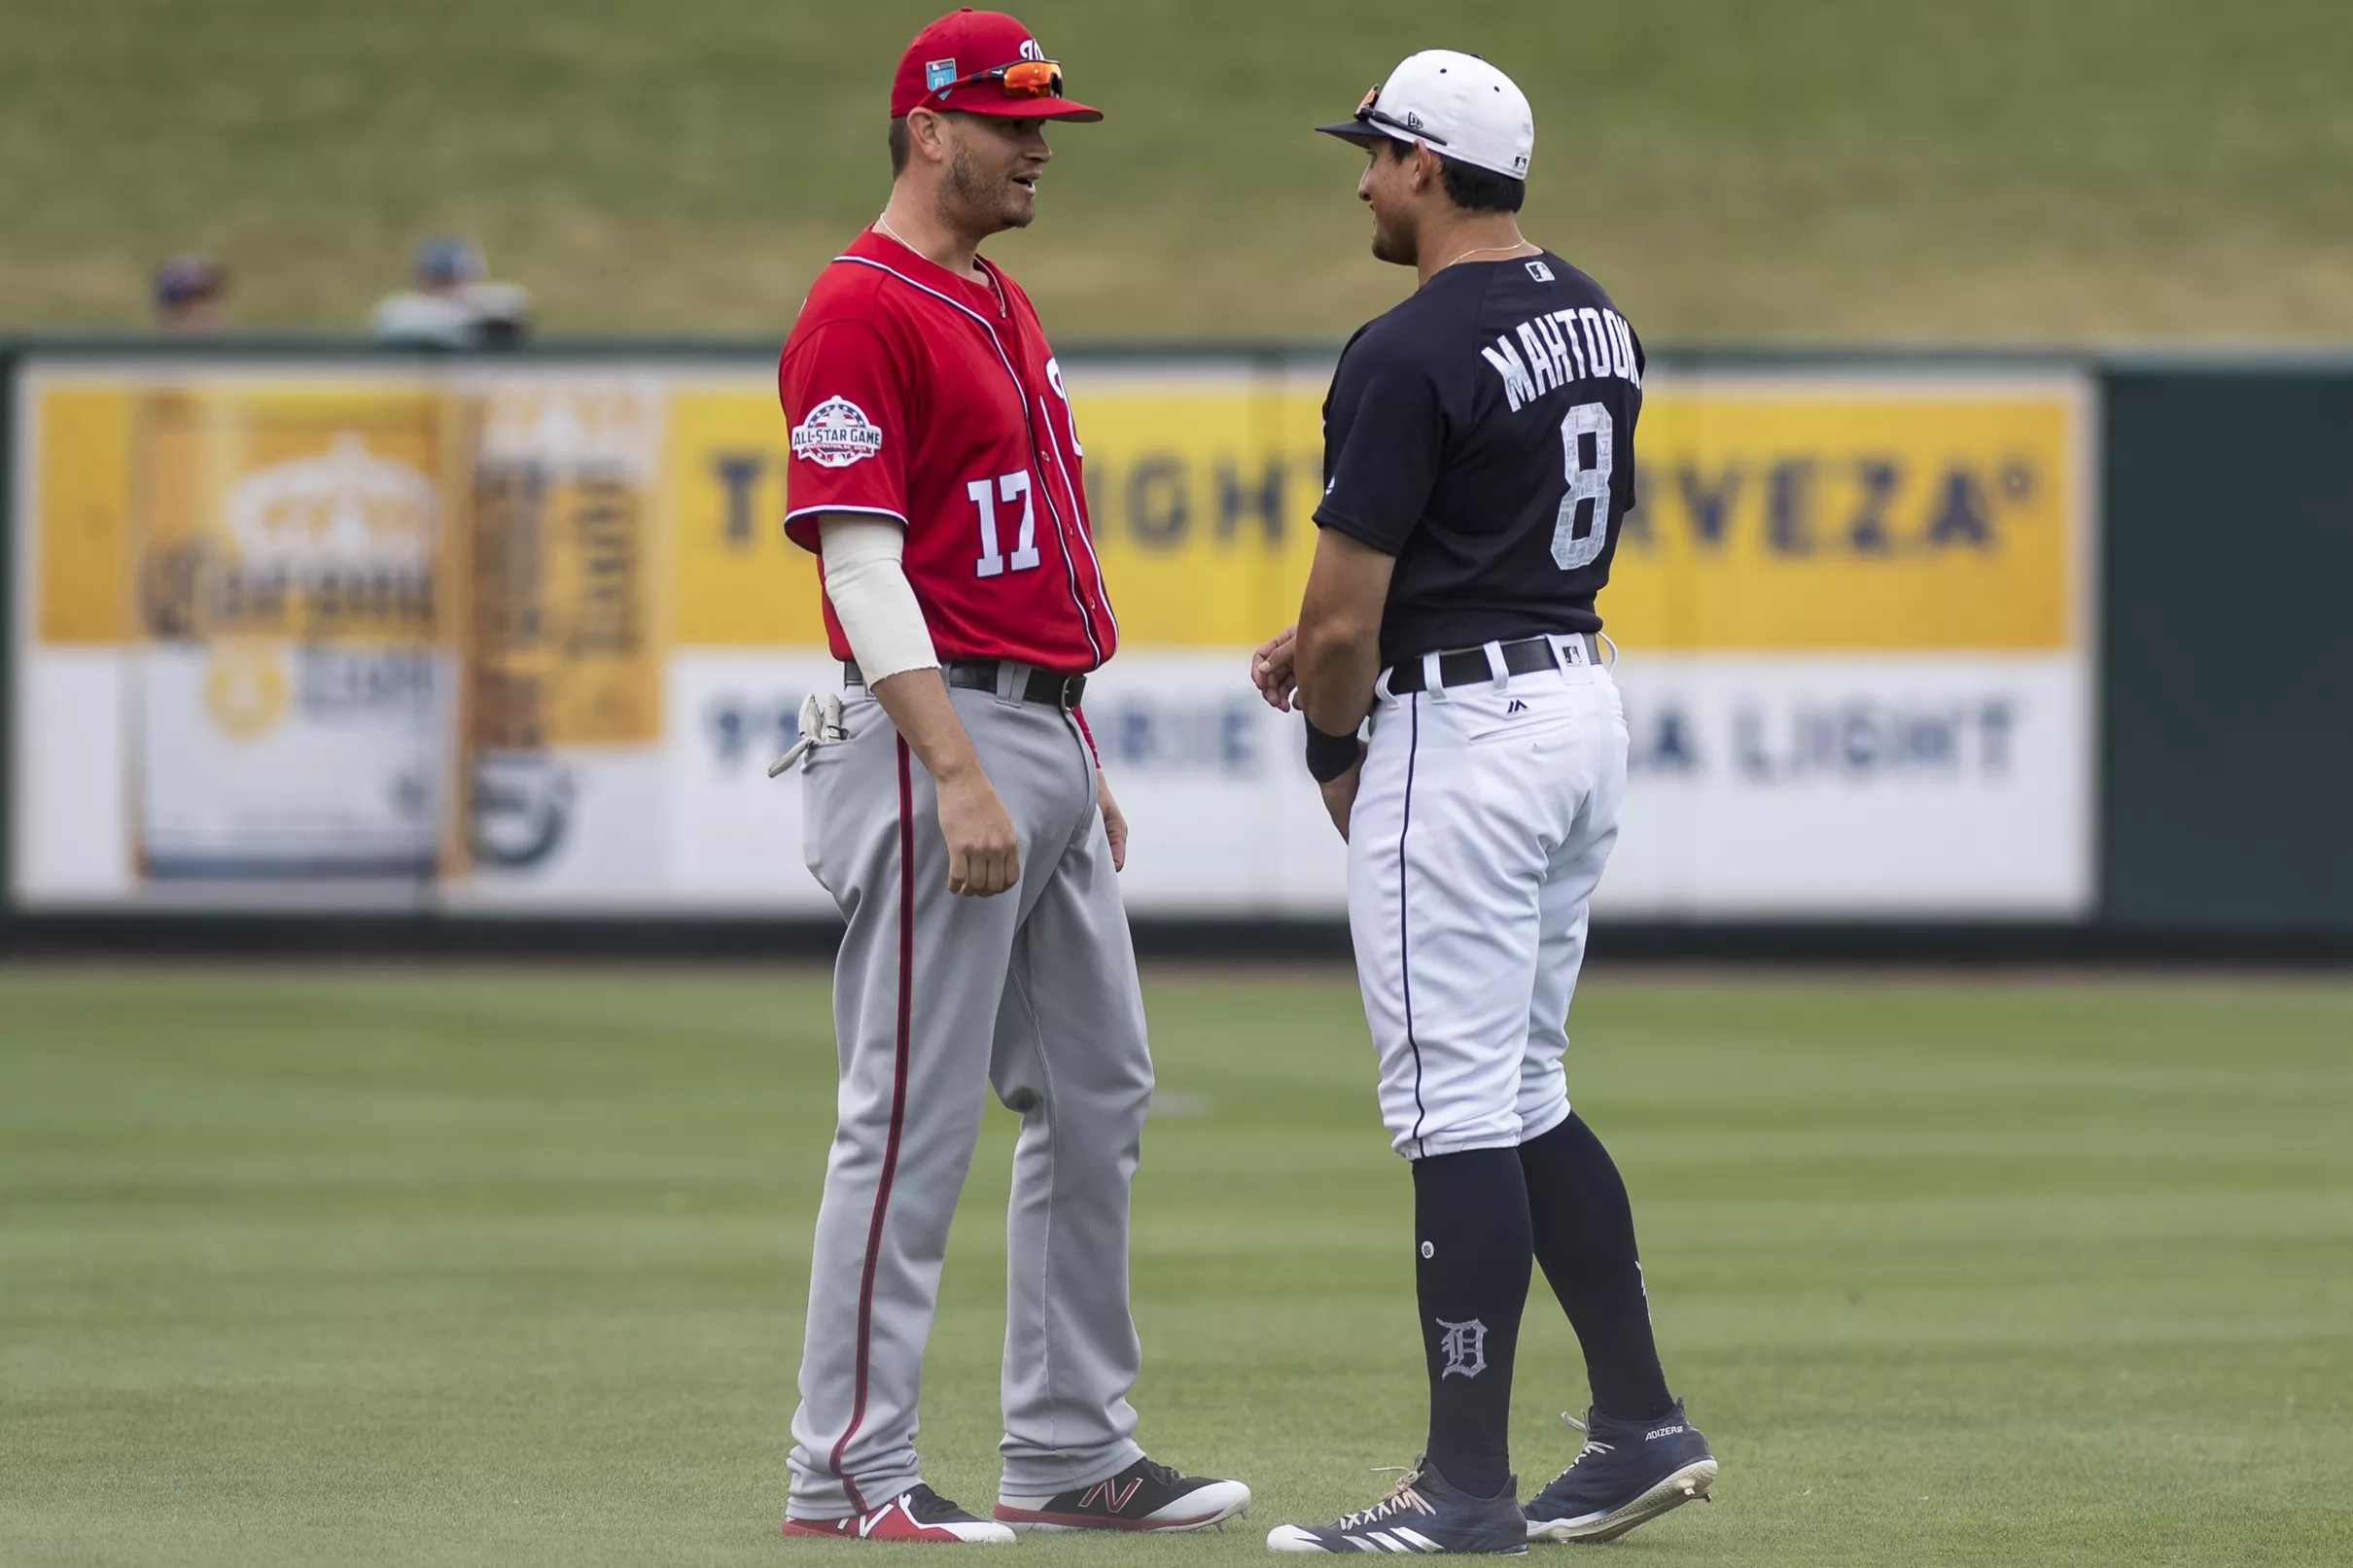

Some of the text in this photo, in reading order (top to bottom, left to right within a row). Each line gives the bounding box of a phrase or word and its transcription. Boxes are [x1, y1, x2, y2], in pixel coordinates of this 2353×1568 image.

[1481, 307, 1640, 412] MAHTOOK
[793, 429, 847, 447] ALL-STAR
[851, 429, 880, 446] GAME
[1551, 401, 1613, 571] 8
[966, 470, 1040, 577] 17
